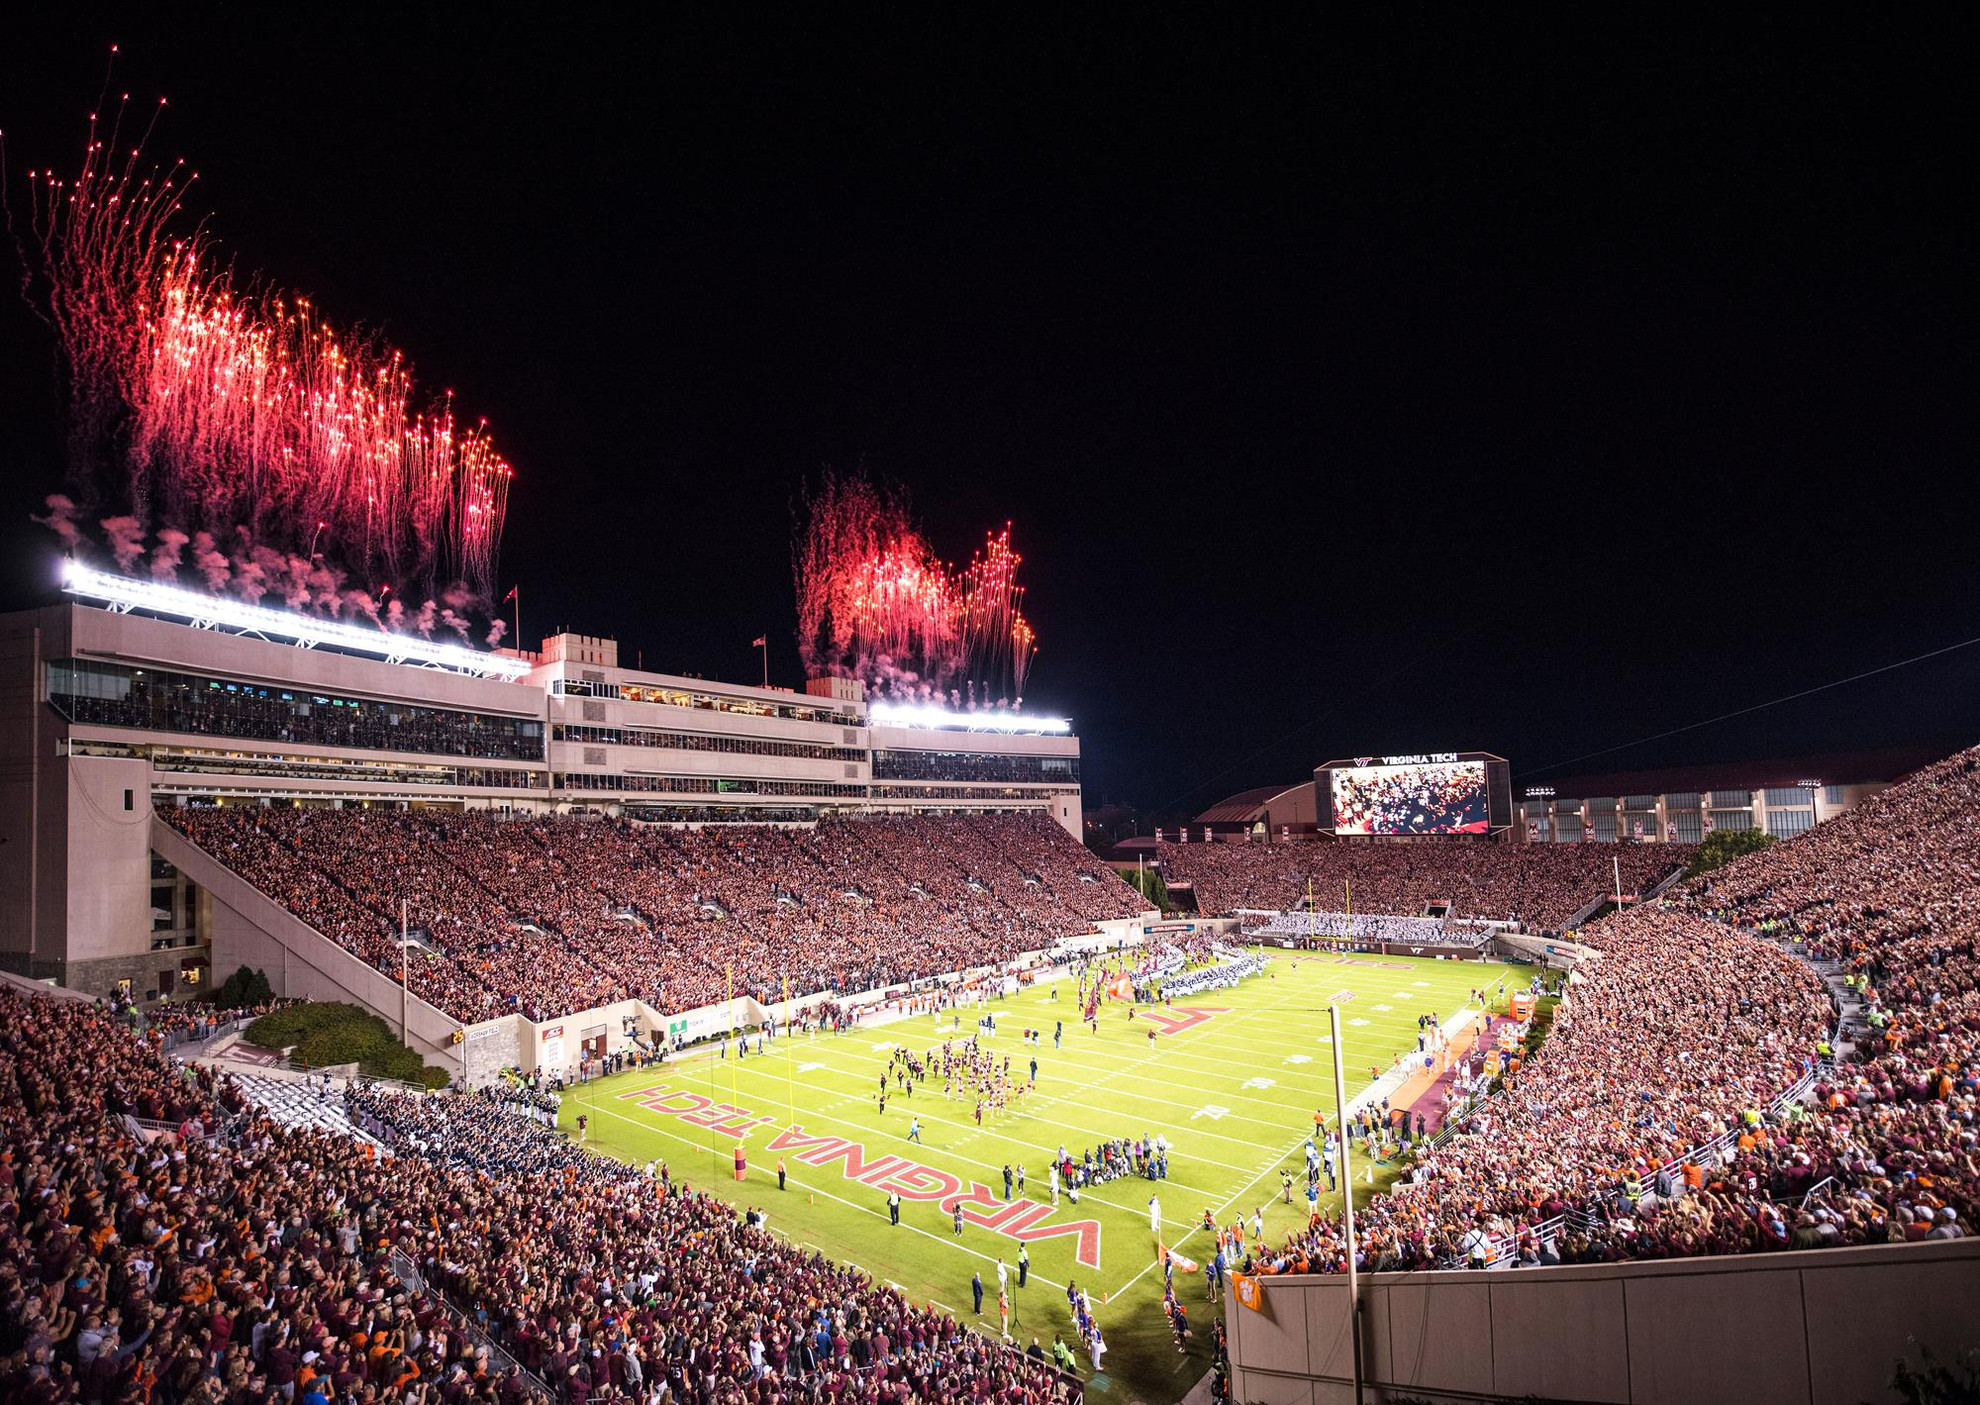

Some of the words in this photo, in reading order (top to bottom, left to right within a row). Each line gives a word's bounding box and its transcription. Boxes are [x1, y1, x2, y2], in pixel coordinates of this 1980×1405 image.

[1353, 757, 1372, 767] VT
[1382, 755, 1428, 766] VIRGINIA
[1430, 752, 1458, 763] TECH
[453, 1030, 464, 1044] 25
[619, 1083, 774, 1138] TECH
[766, 1124, 1102, 1270] VIRGINIA
